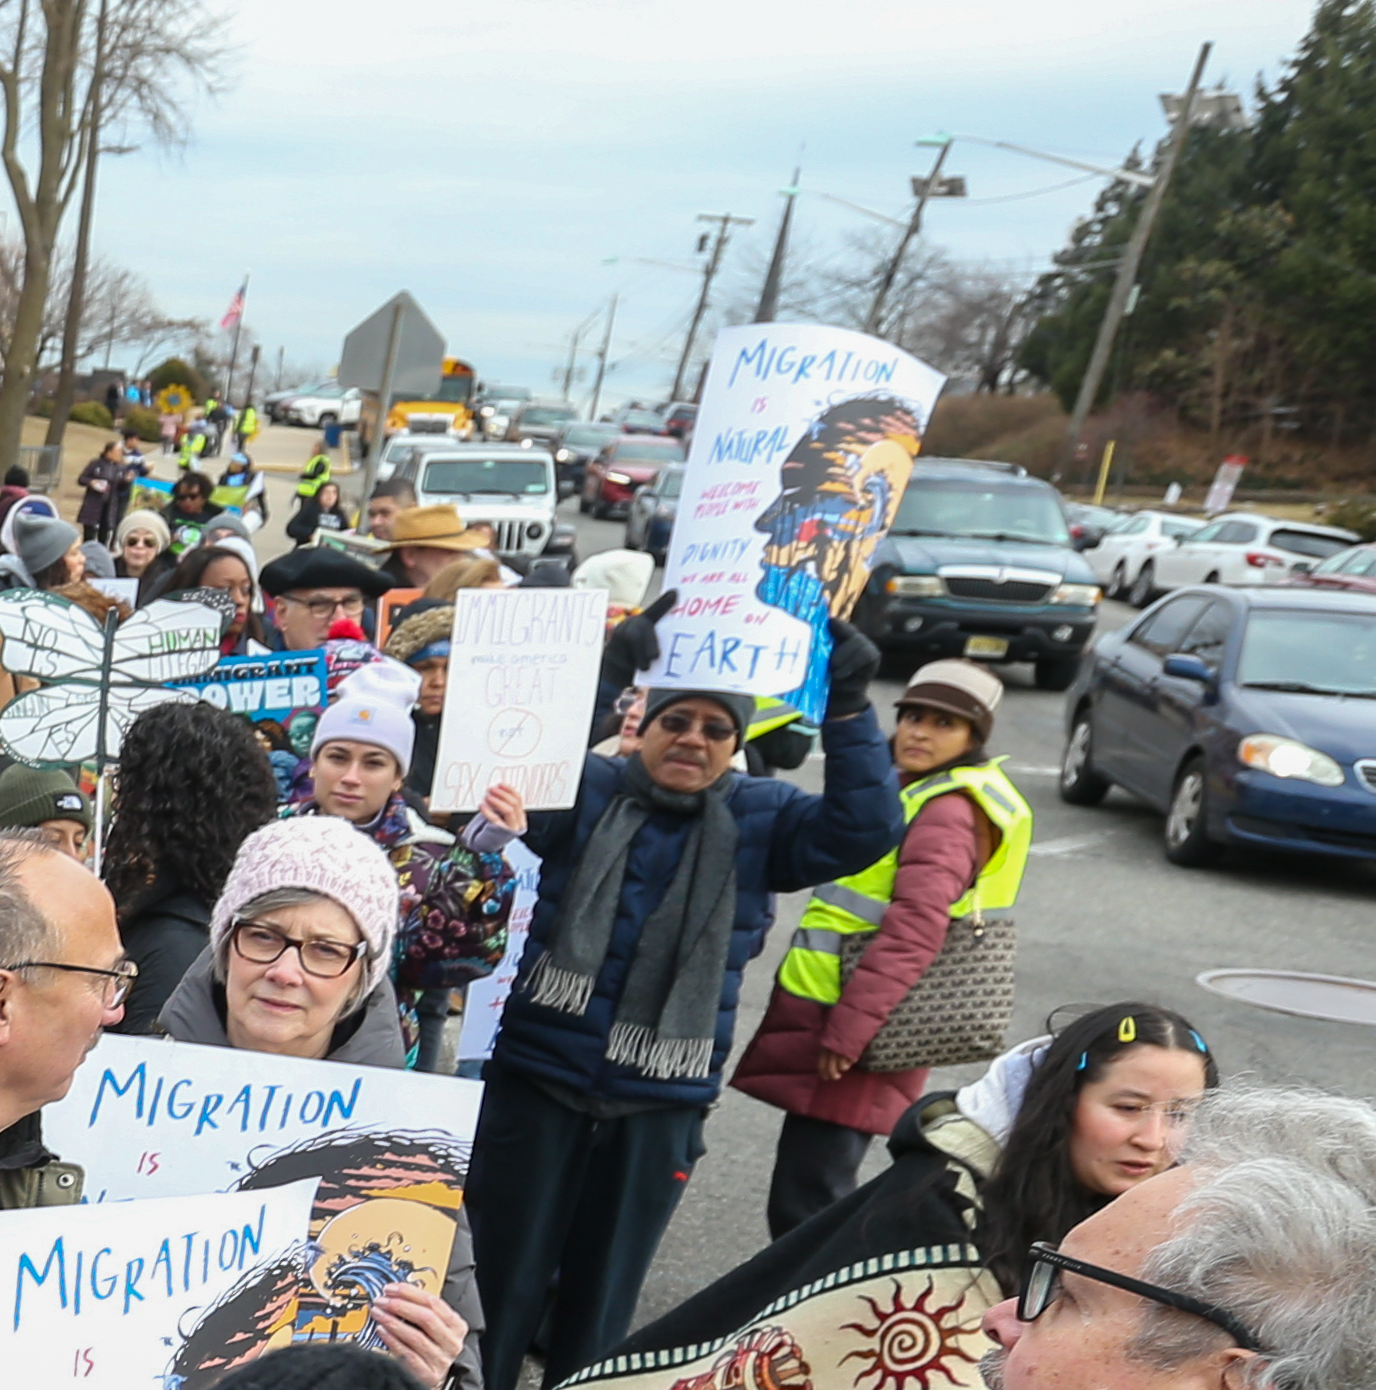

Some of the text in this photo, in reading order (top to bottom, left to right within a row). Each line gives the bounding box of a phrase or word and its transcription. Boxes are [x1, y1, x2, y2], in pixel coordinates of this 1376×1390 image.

[727, 338, 899, 389] MIGRATION
[751, 397, 767, 414] IS
[708, 425, 793, 465] NATURAL
[681, 538, 753, 567] DIGNITY
[454, 591, 605, 647] IMMIGRANTS
[668, 593, 743, 617] HOME
[21, 618, 59, 650] NO
[147, 627, 222, 655] HUMAN
[664, 628, 802, 680] EARTH
[485, 665, 561, 708] GREAT
[88, 1061, 363, 1137] MIGRATION
[136, 1151, 161, 1177] IS
[13, 1203, 268, 1334] MIGRATION
[73, 1347, 95, 1379] IS
